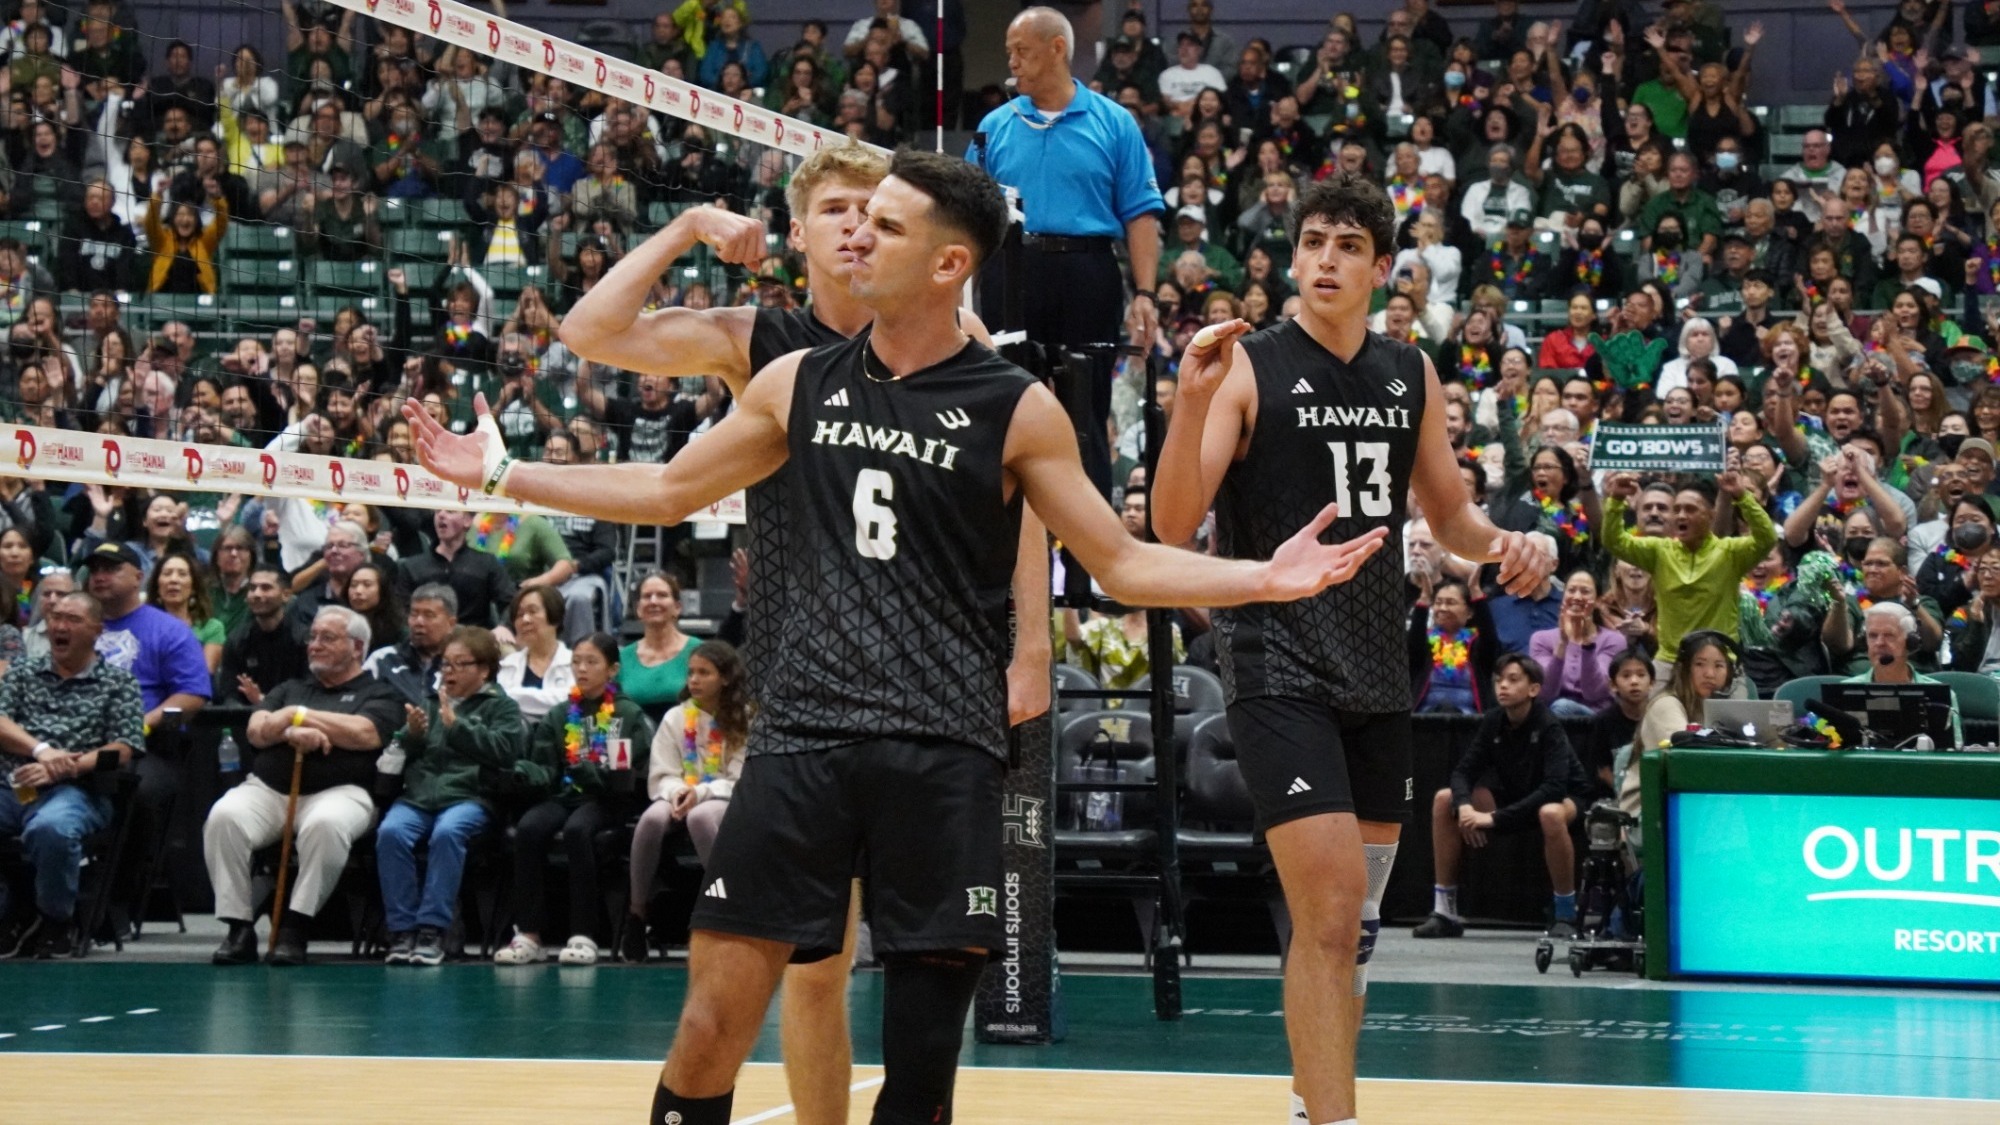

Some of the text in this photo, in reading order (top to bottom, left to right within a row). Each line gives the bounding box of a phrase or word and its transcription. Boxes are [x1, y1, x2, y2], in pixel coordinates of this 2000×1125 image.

[852, 468, 898, 561] 6
[1326, 441, 1393, 518] 13
[1802, 825, 2000, 883] OUTR
[1003, 872, 1022, 1013] sports imports
[1894, 928, 2000, 954] RESORT
